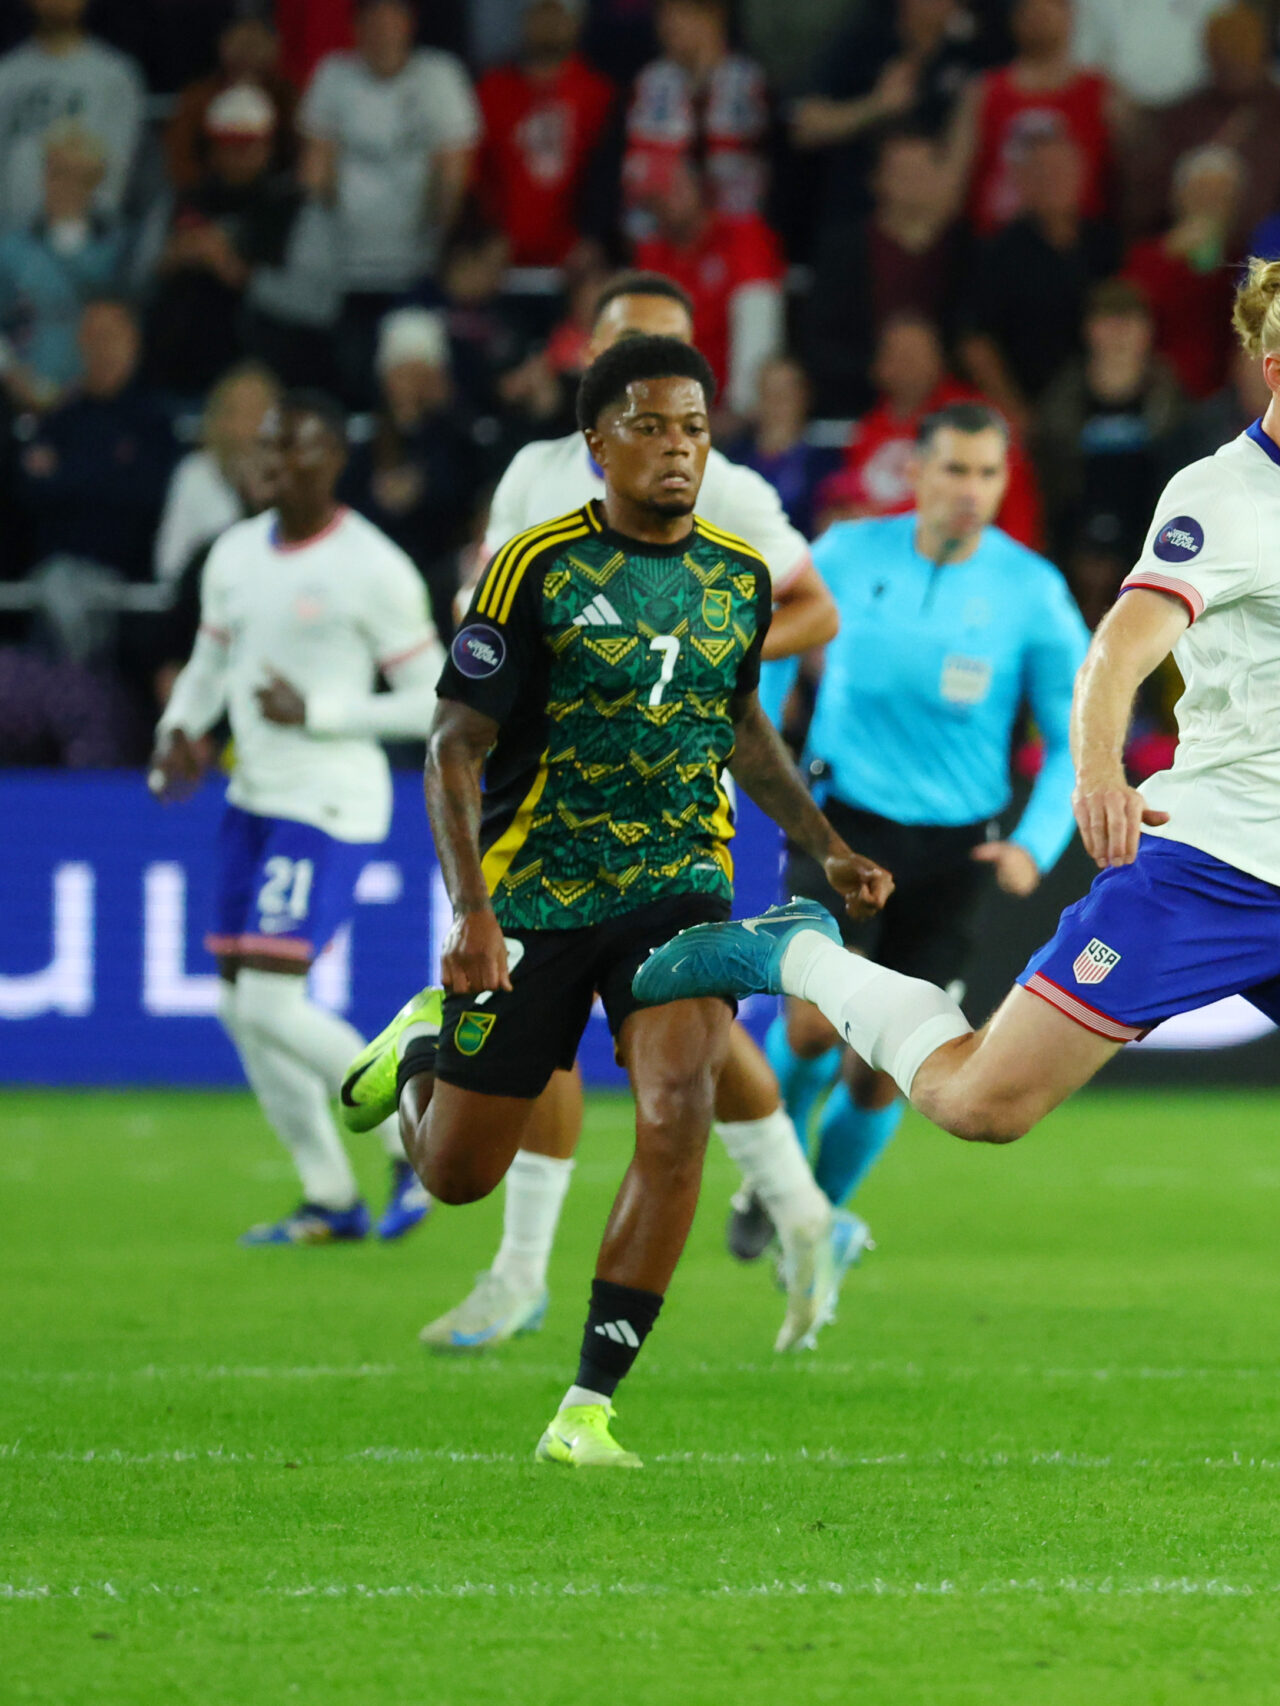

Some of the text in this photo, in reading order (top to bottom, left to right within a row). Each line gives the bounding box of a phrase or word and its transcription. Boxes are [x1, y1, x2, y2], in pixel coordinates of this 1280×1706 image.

[648, 634, 680, 706] 7
[258, 855, 314, 919] 21
[1087, 940, 1118, 966] USA
